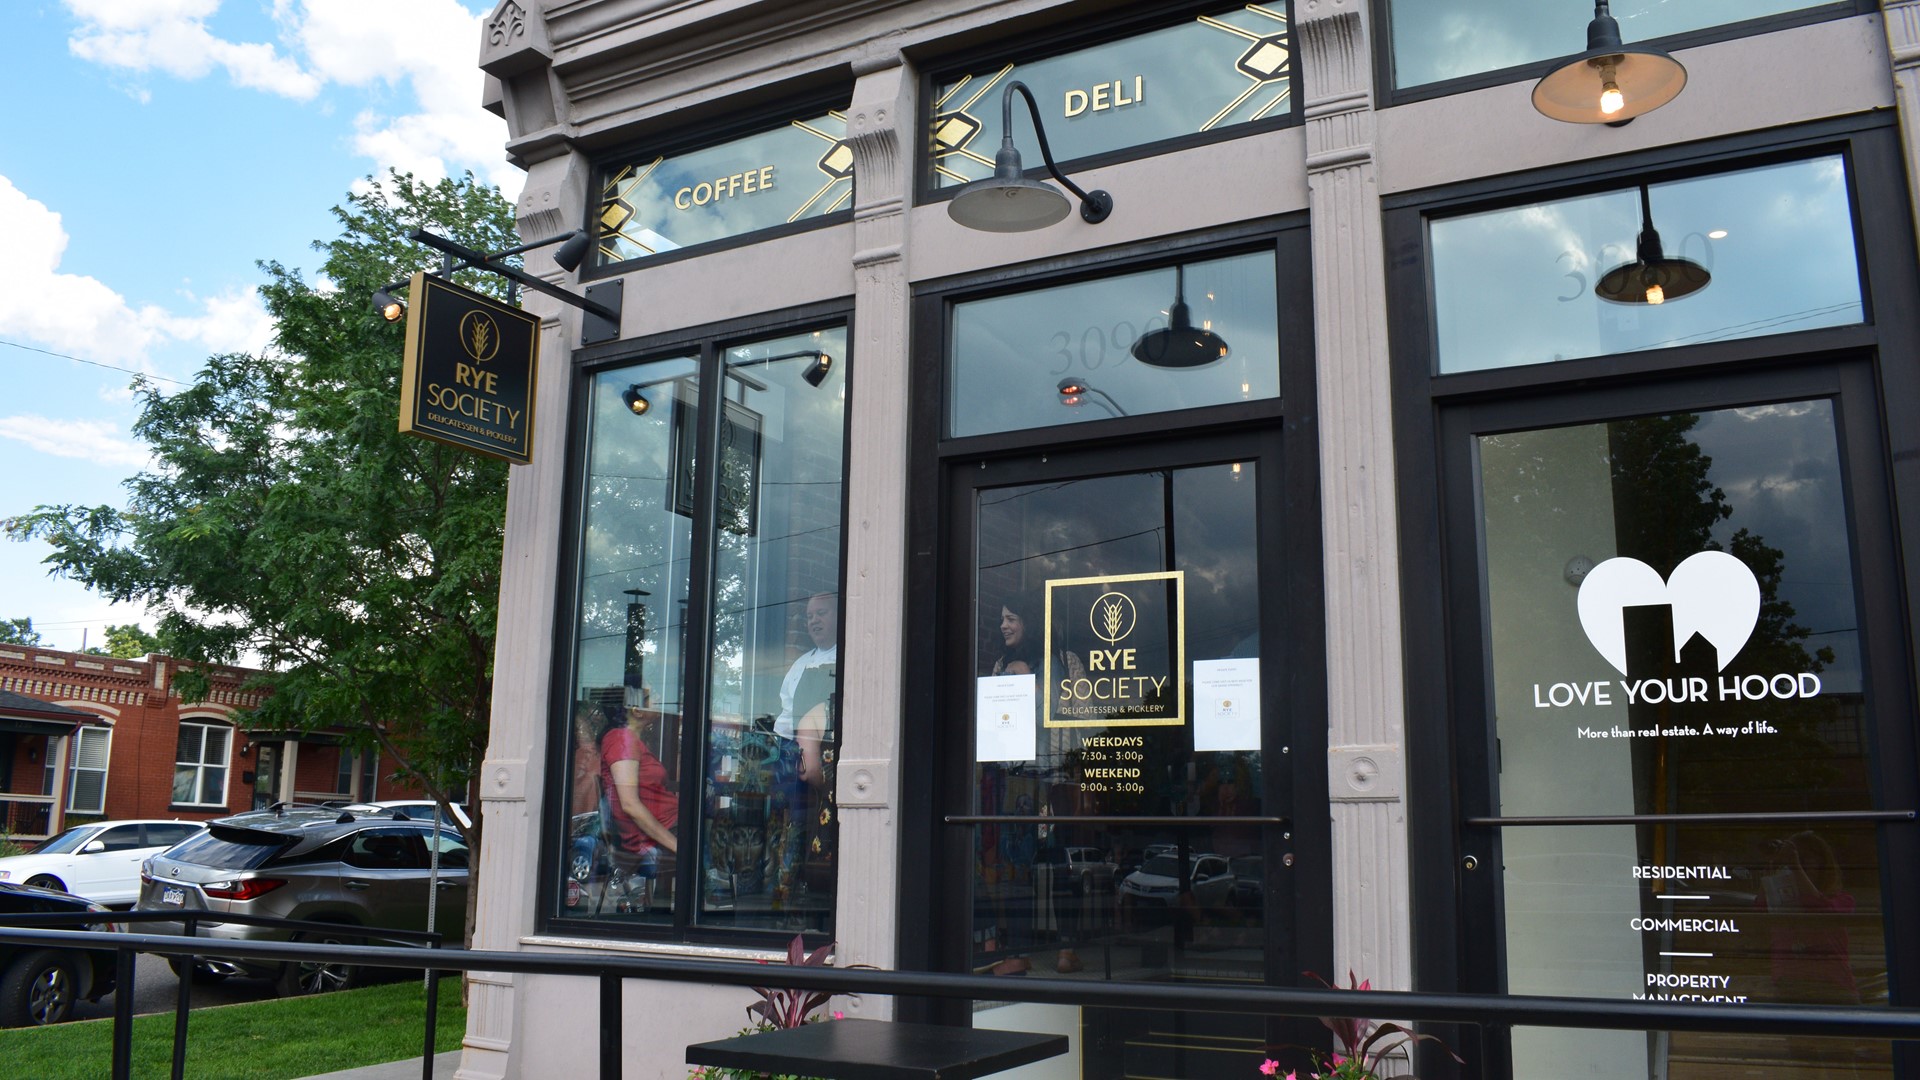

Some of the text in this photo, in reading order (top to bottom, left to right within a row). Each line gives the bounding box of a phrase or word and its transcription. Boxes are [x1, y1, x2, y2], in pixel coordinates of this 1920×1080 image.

[1064, 75, 1143, 119] DELI
[674, 165, 775, 210] COFFEE
[1049, 316, 1170, 376] 3090
[455, 362, 498, 395] RYE
[427, 383, 520, 430] SOCIETY
[428, 412, 517, 445] DELICATESSEN & PICKLERY
[1089, 648, 1137, 671] RYE
[1060, 675, 1168, 700] SOCIETY
[1533, 672, 1821, 708] LOVE YOUR HOOD
[1062, 705, 1165, 715] DELICATESSEN & PICKLERY
[1577, 721, 1778, 738] More than real estate. A way of life.
[1081, 736, 1143, 747] WEEKDAYS
[1081, 751, 1107, 760] 7:30a
[1115, 751, 1144, 763] 3:00p
[1084, 768, 1141, 778] WEEKEND
[1080, 782, 1107, 792] 9:00a
[1116, 782, 1144, 794] 3:00p
[1632, 865, 1732, 880] RESIDENTIAL
[1630, 918, 1740, 933] COMMERCIAL
[1647, 973, 1731, 989] PROPERTY
